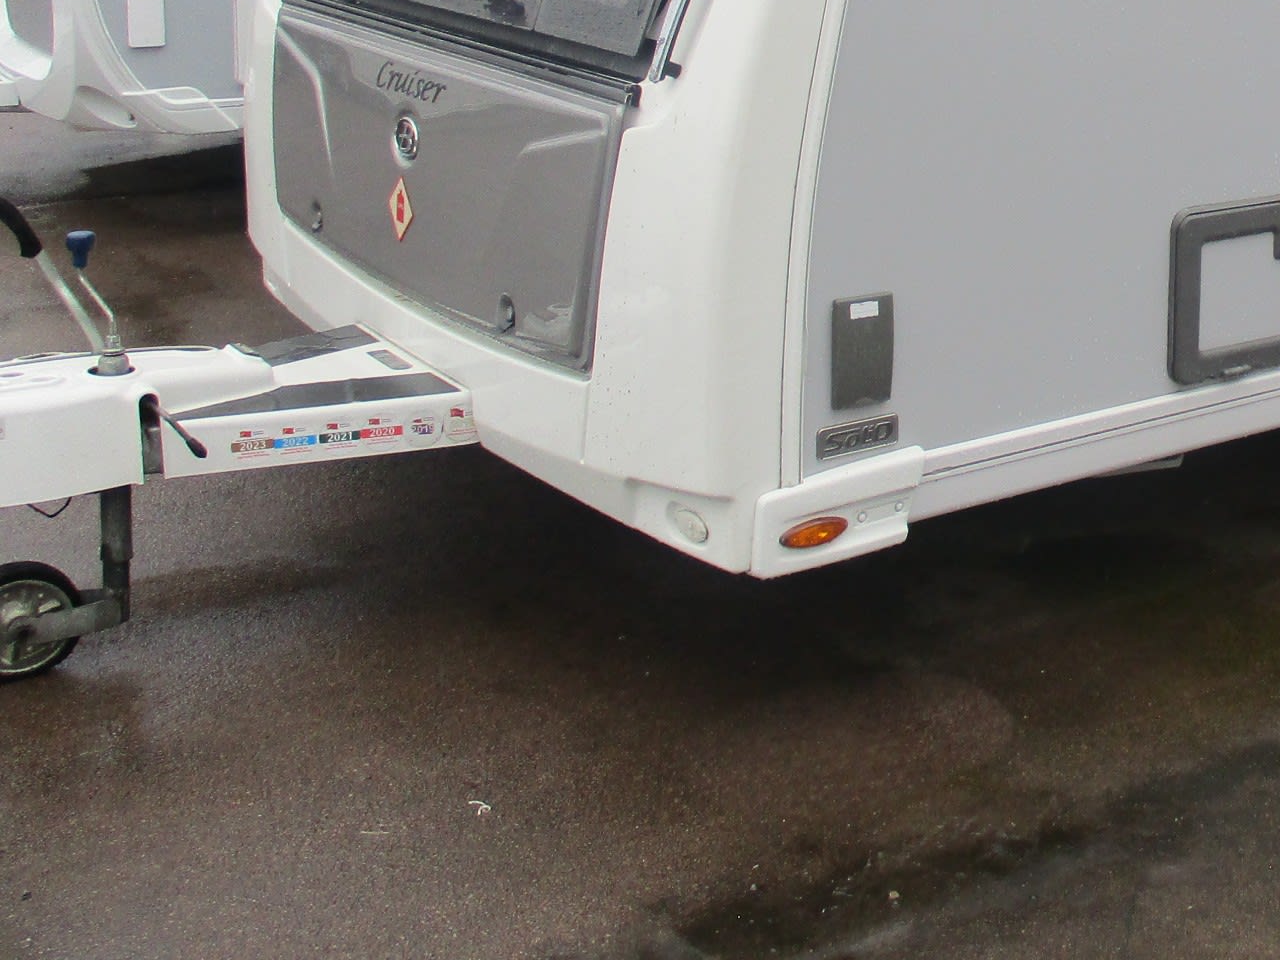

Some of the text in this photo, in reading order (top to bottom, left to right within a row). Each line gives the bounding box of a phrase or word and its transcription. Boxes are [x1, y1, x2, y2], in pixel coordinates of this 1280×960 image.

[376, 60, 447, 104] Cruiser
[327, 431, 352, 442] 2021
[369, 427, 395, 437] 2020
[239, 440, 267, 451] 2023
[283, 436, 309, 447] 2022
